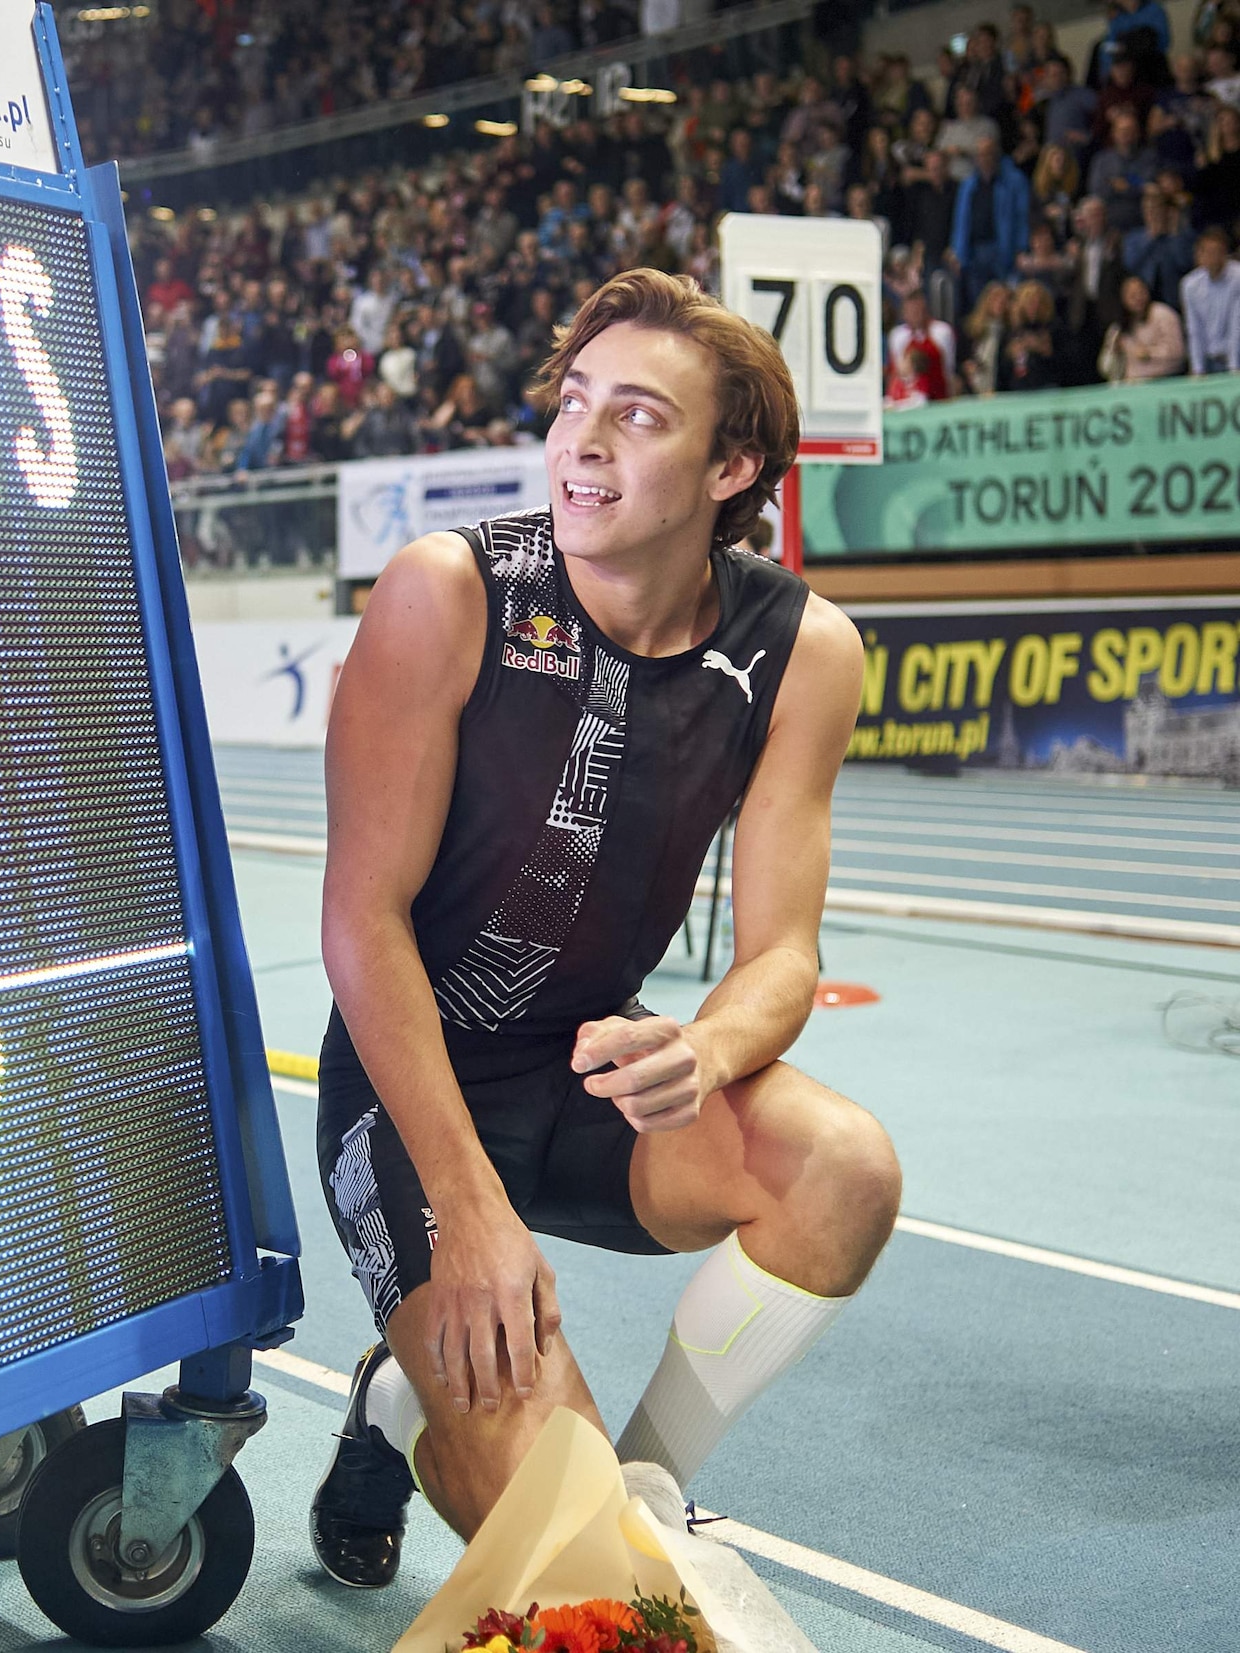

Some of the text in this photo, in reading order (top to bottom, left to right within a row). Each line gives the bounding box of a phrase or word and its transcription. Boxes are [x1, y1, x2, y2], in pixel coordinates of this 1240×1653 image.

[751, 278, 866, 375] 70
[932, 403, 1134, 460] ATHLETICS
[947, 455, 1240, 526] TORUŃ 202
[501, 642, 580, 680] Red Bull
[898, 637, 1008, 714] CITY
[1007, 632, 1083, 708] OF
[1086, 619, 1240, 703] SPOR
